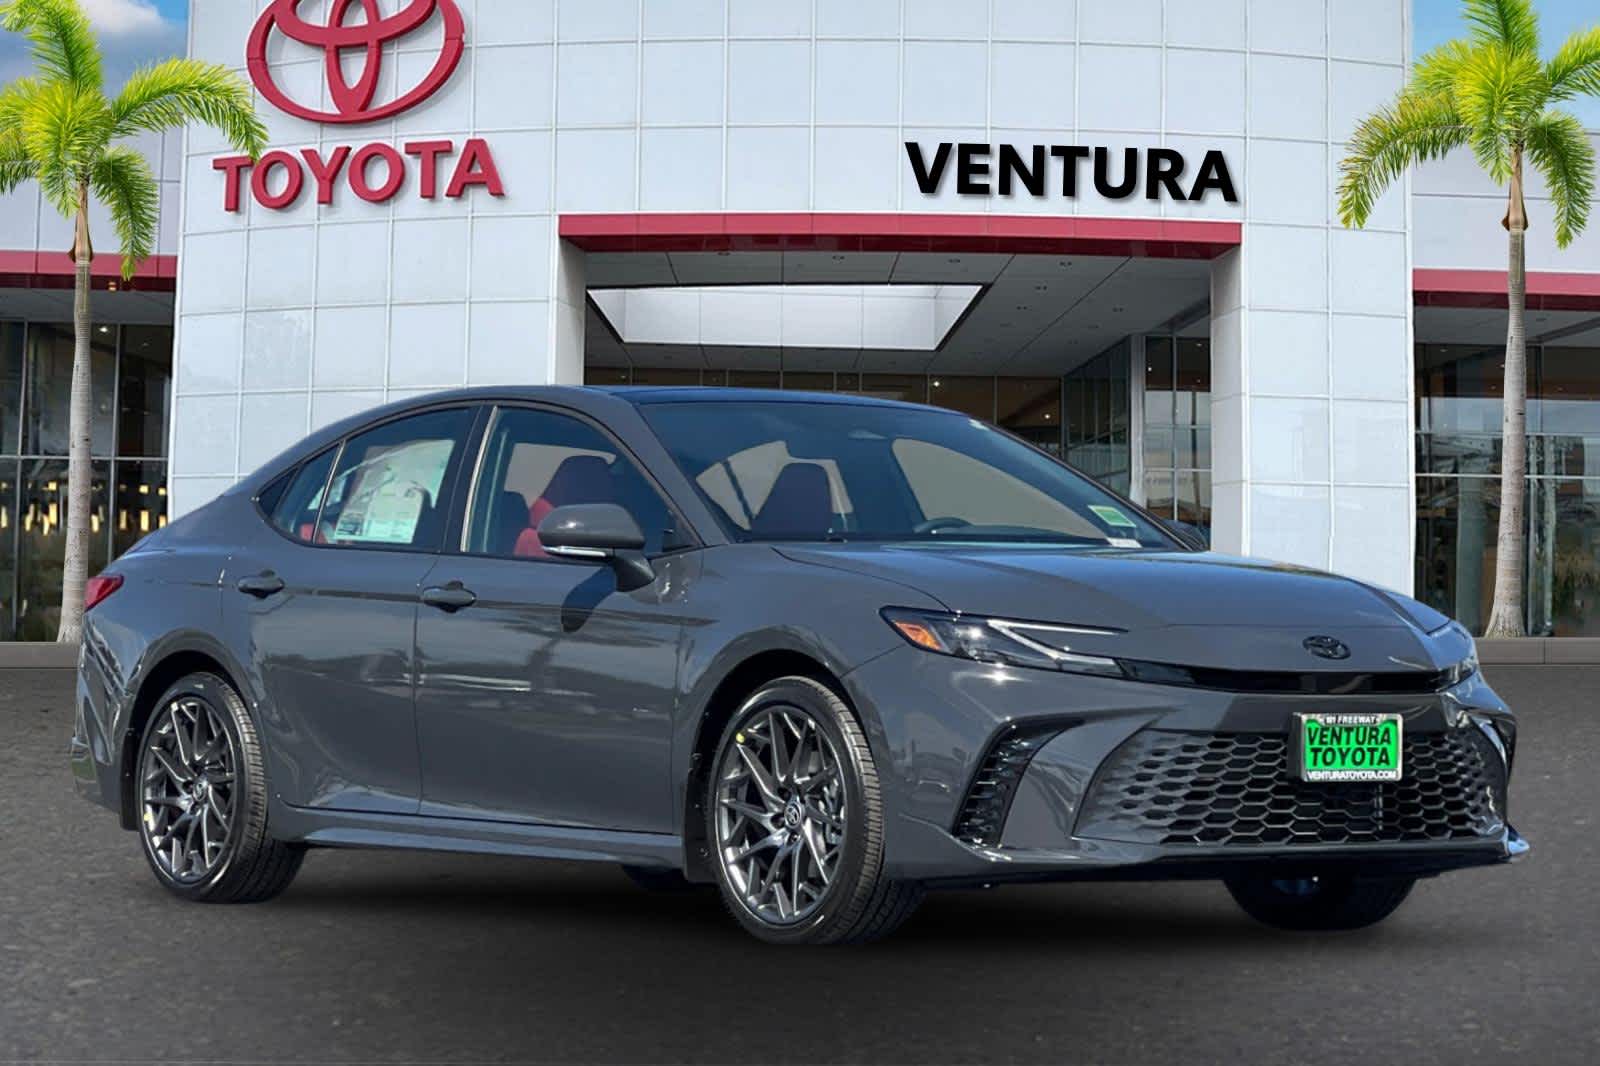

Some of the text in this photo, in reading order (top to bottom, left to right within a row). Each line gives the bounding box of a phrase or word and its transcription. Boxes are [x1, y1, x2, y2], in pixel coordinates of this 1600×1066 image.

[212, 138, 505, 213] TOYOTA
[904, 141, 1239, 203] VENTURA
[1307, 727, 1391, 746] VENTURA
[1310, 747, 1390, 767] TOYOTA
[1307, 770, 1396, 780] VENTURATOYOTA.COM
